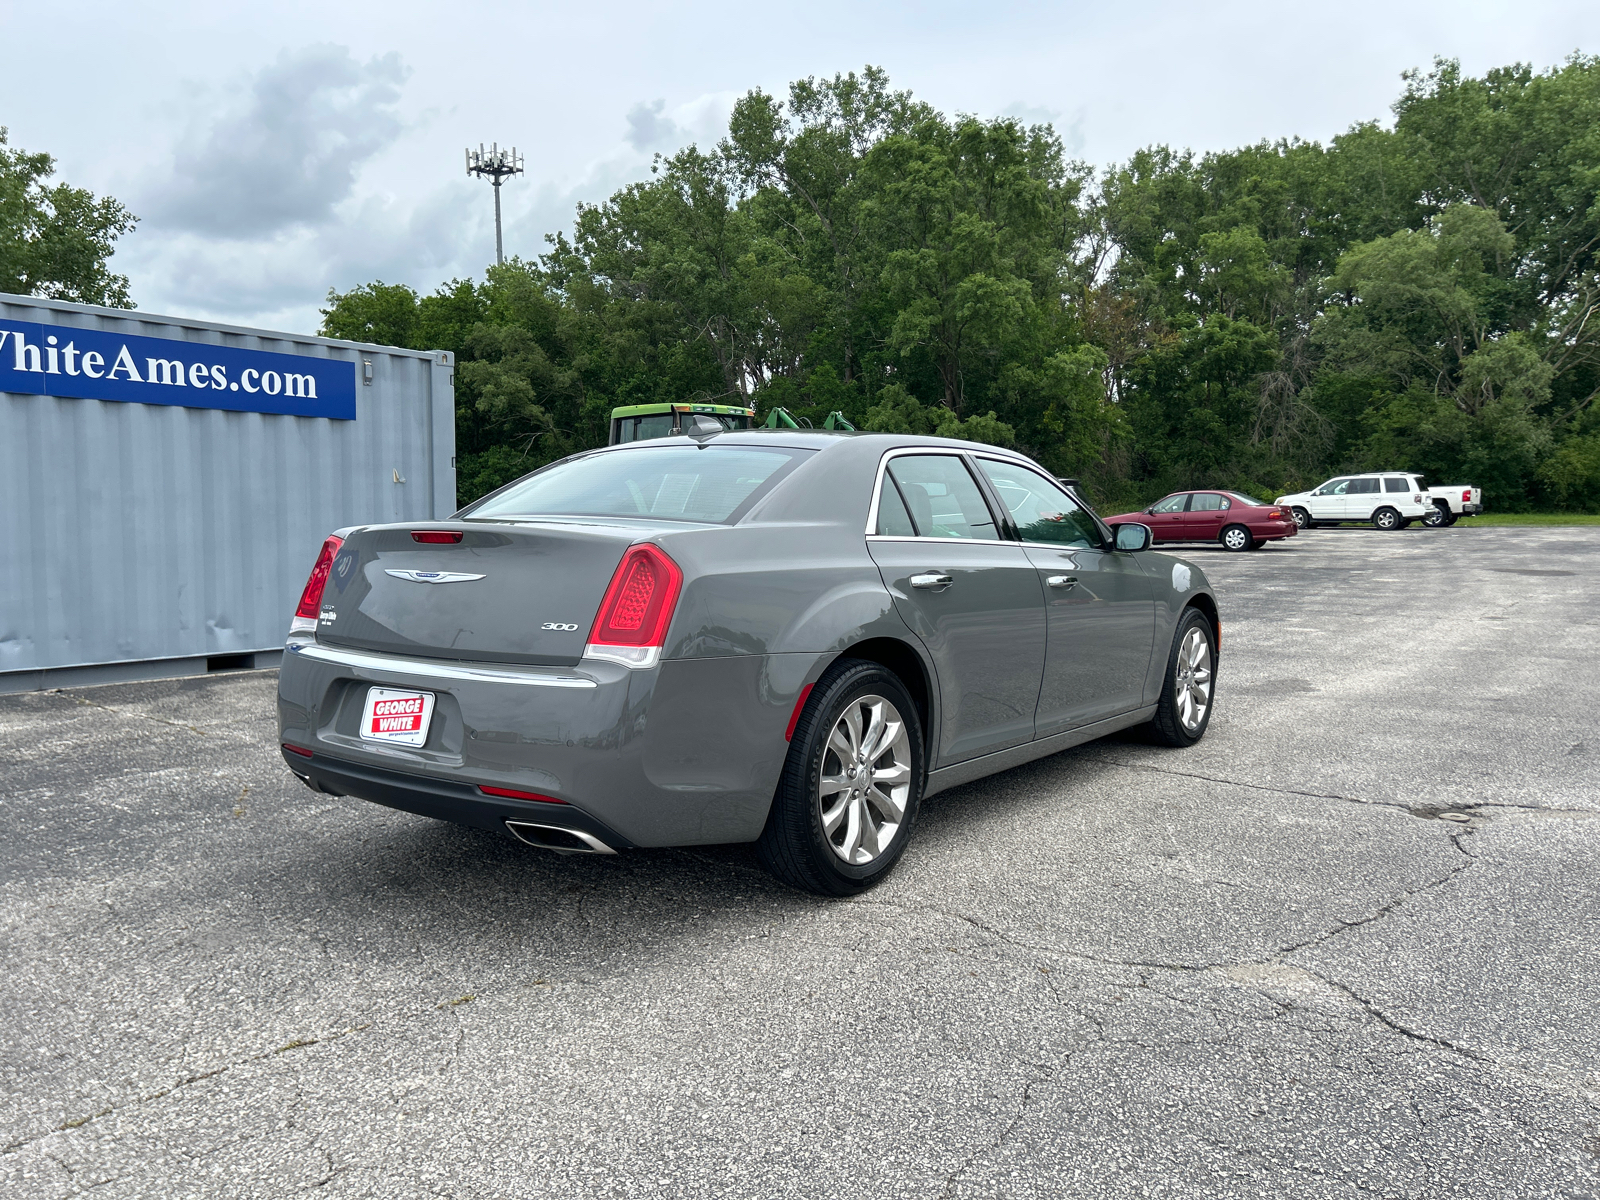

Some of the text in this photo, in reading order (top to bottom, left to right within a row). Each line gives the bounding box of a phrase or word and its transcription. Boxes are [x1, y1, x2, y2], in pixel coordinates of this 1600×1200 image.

[541, 622, 579, 631] 300
[376, 699, 422, 715] GEORGE
[380, 717, 414, 731] WHITE
